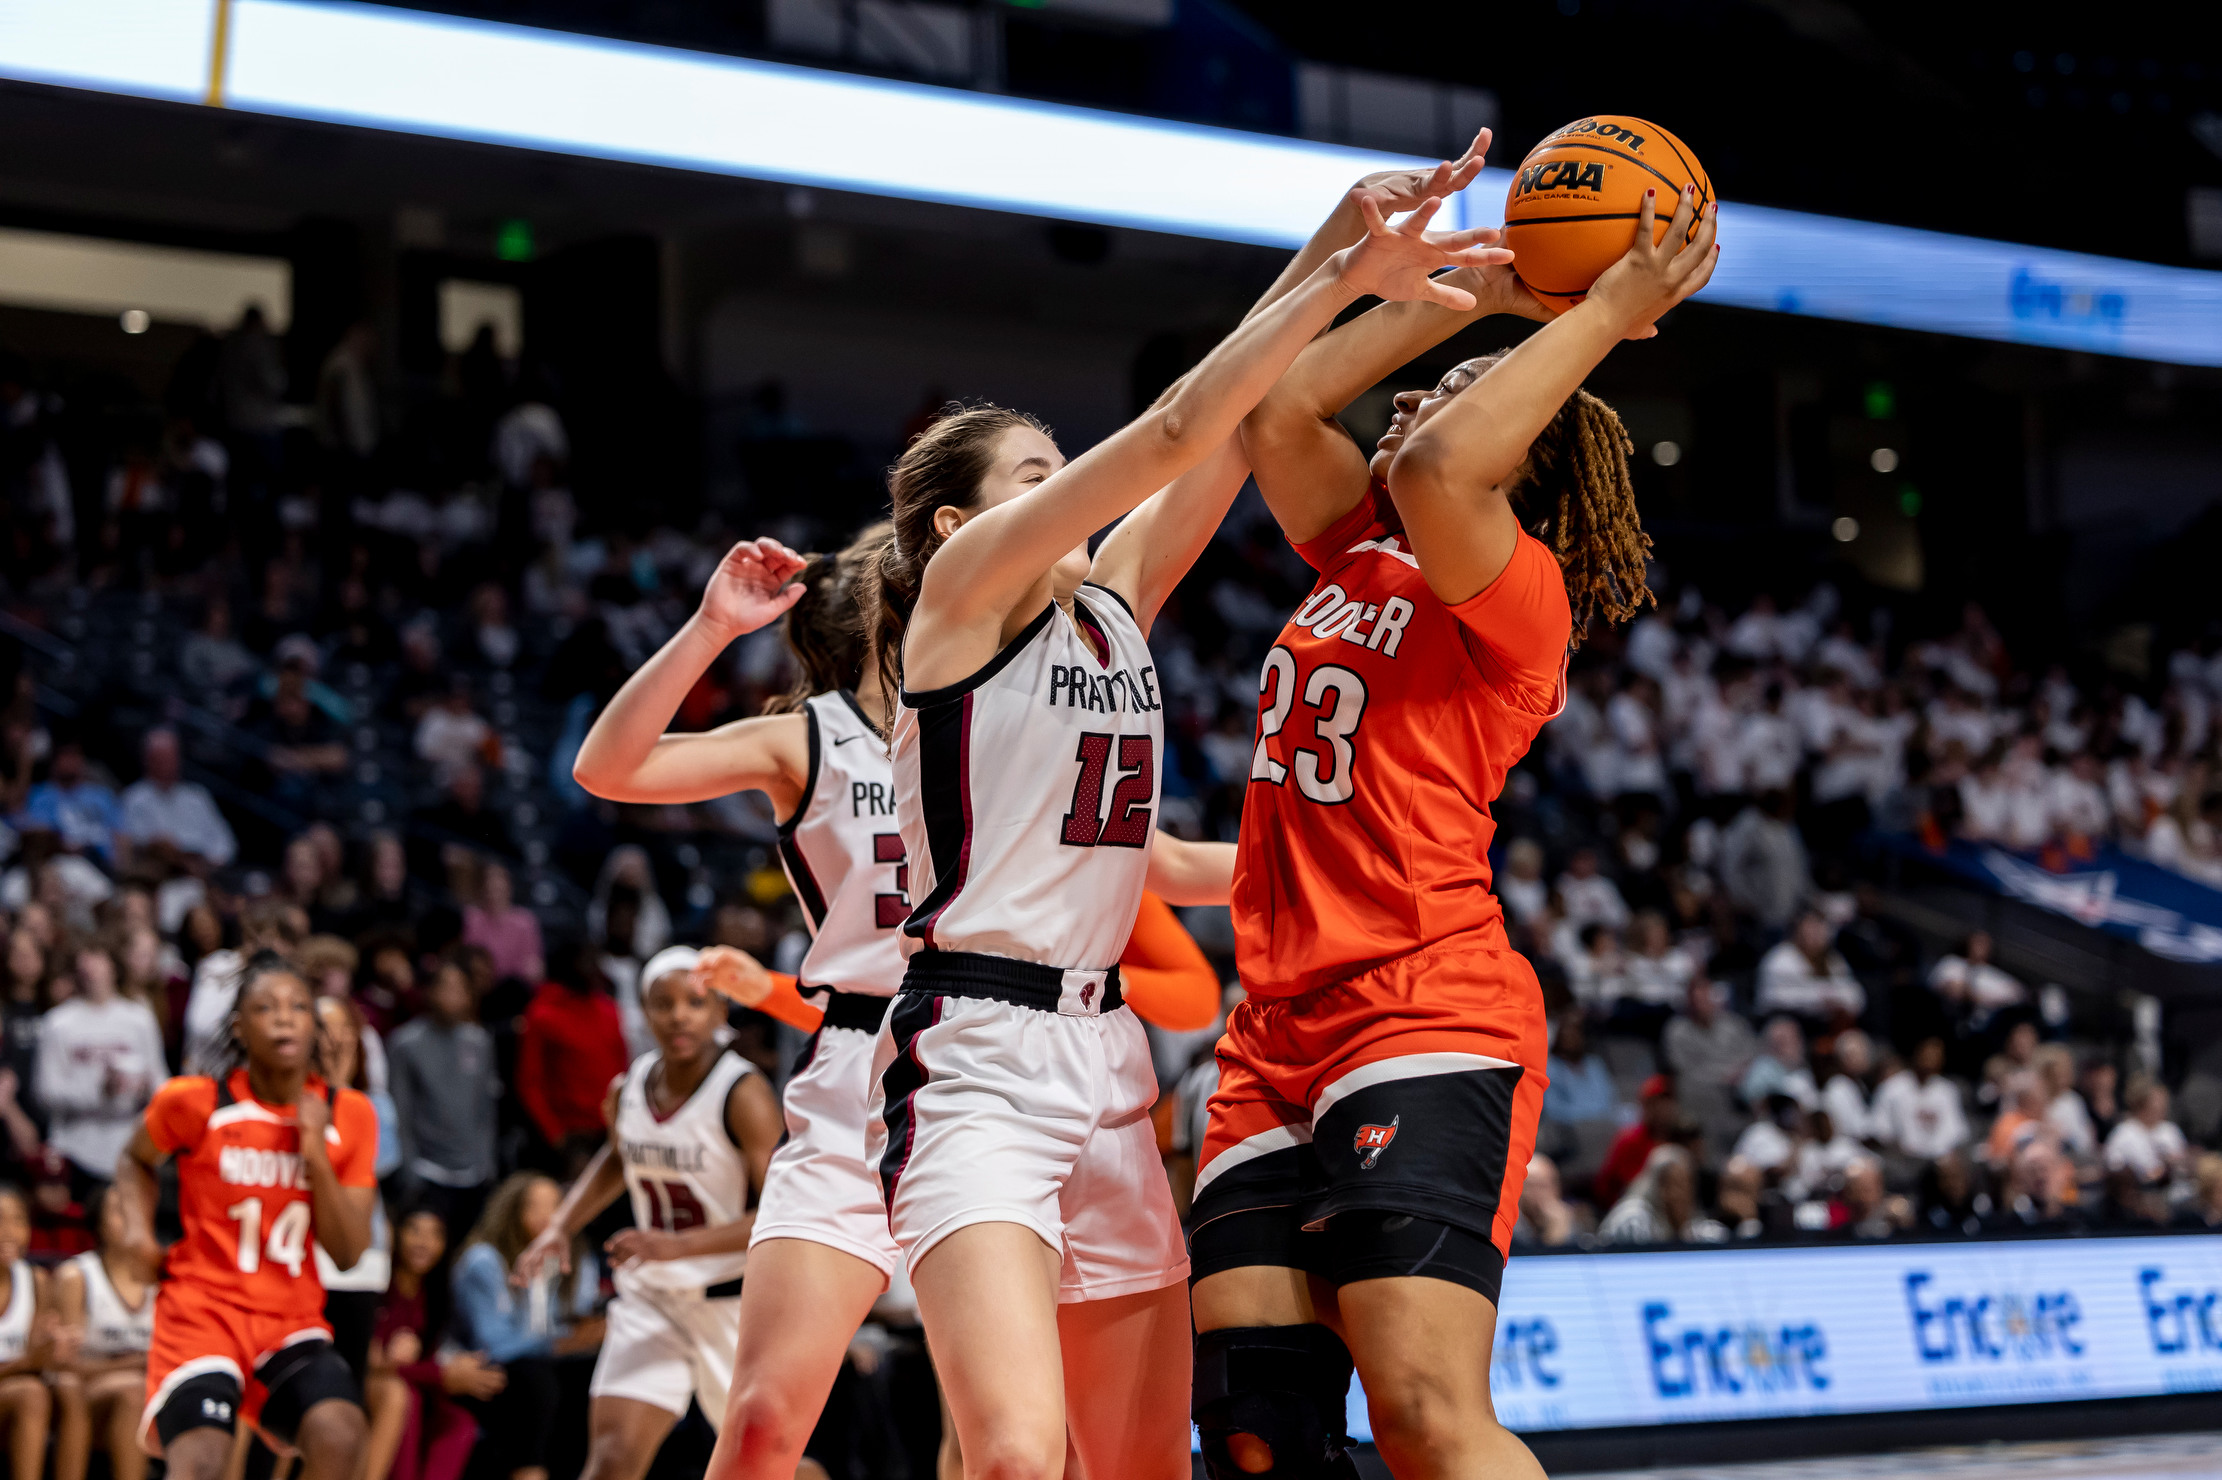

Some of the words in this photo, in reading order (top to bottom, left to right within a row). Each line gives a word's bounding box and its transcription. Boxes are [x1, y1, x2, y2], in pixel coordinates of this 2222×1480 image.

[1515, 161, 1606, 198] NCAA
[1573, 194, 1600, 202] BALL
[1290, 583, 1415, 660] OOER
[1251, 644, 1369, 806] 23
[1060, 731, 1153, 849] 12
[219, 1145, 311, 1190] HOOVE
[228, 1197, 311, 1277] 14
[1643, 1301, 1831, 1398] Encre
[1905, 1270, 2084, 1364] Encre
